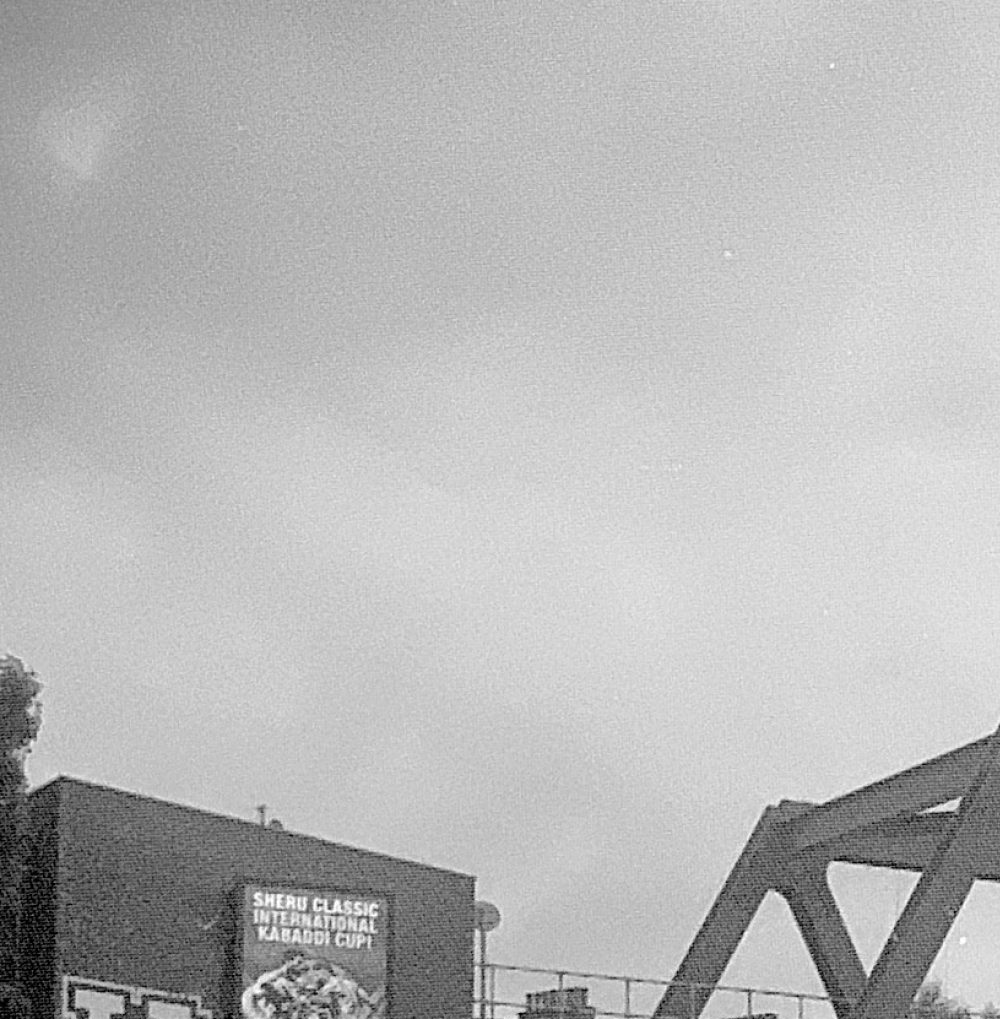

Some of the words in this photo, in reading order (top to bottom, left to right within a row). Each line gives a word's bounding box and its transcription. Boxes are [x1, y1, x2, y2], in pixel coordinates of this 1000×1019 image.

[253, 892, 308, 911] SHERU
[312, 897, 379, 917] CLASSIC
[253, 909, 378, 934] INTERNATIONAL
[258, 926, 331, 945] KABADDI
